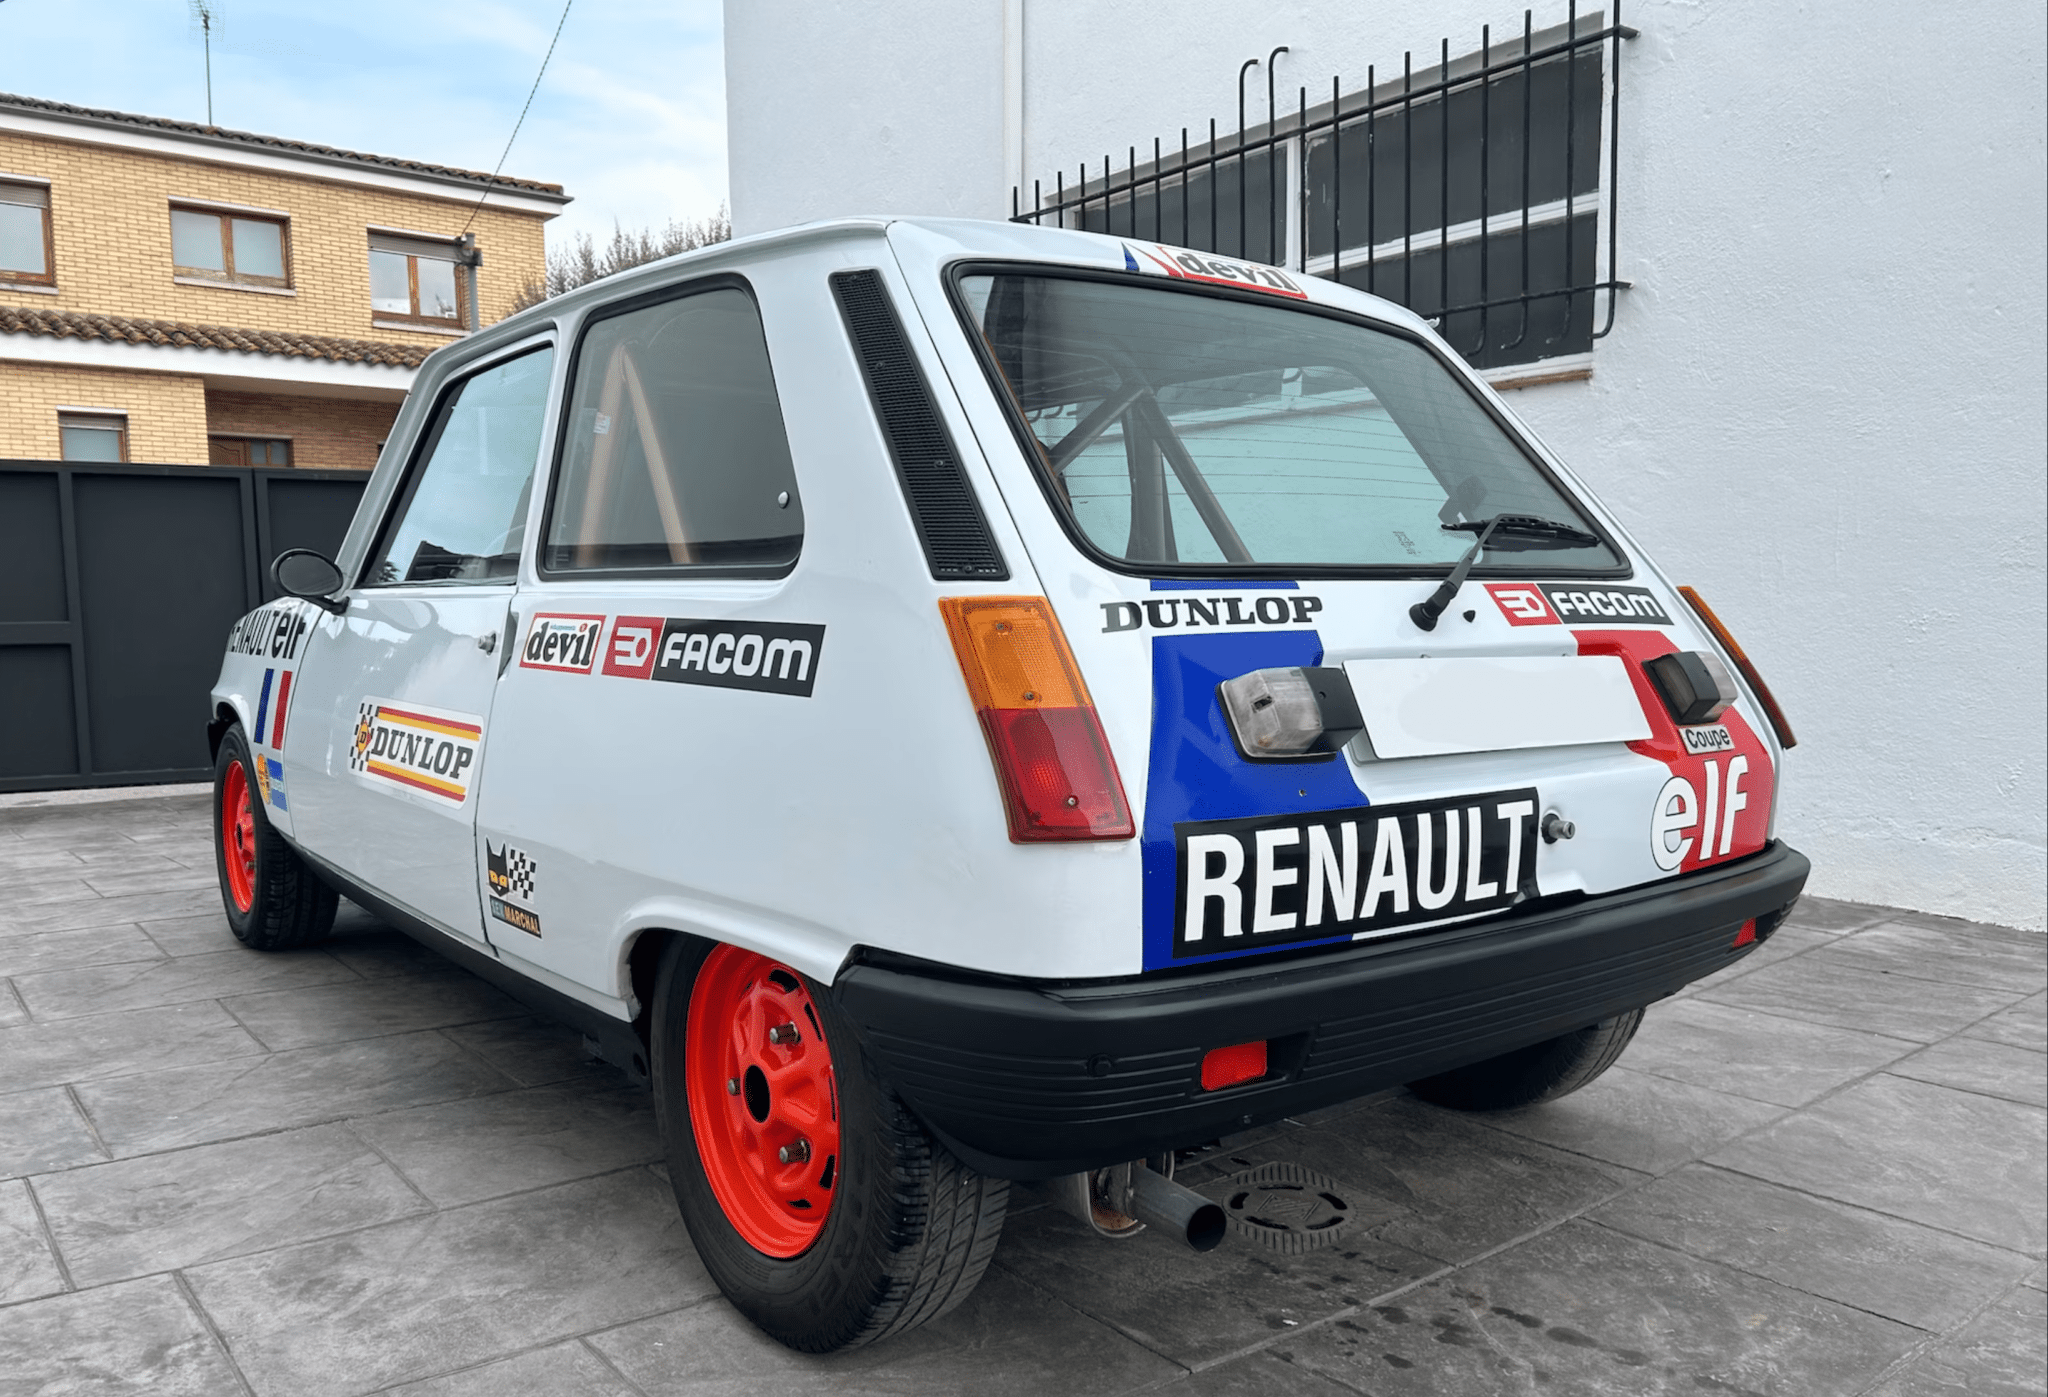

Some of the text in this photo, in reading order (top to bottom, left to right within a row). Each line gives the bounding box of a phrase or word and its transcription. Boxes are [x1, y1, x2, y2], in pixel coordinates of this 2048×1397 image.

[1176, 252, 1299, 292] devil
[1100, 596, 1323, 633] DUNLOP
[1551, 591, 1665, 618] FACOM
[527, 621, 599, 666] devil
[660, 632, 812, 681] FACOM
[370, 726, 474, 779] DUNLOP
[1685, 728, 1730, 749] Coupe
[1650, 754, 1748, 871] elf
[1184, 800, 1533, 942] RENAULT
